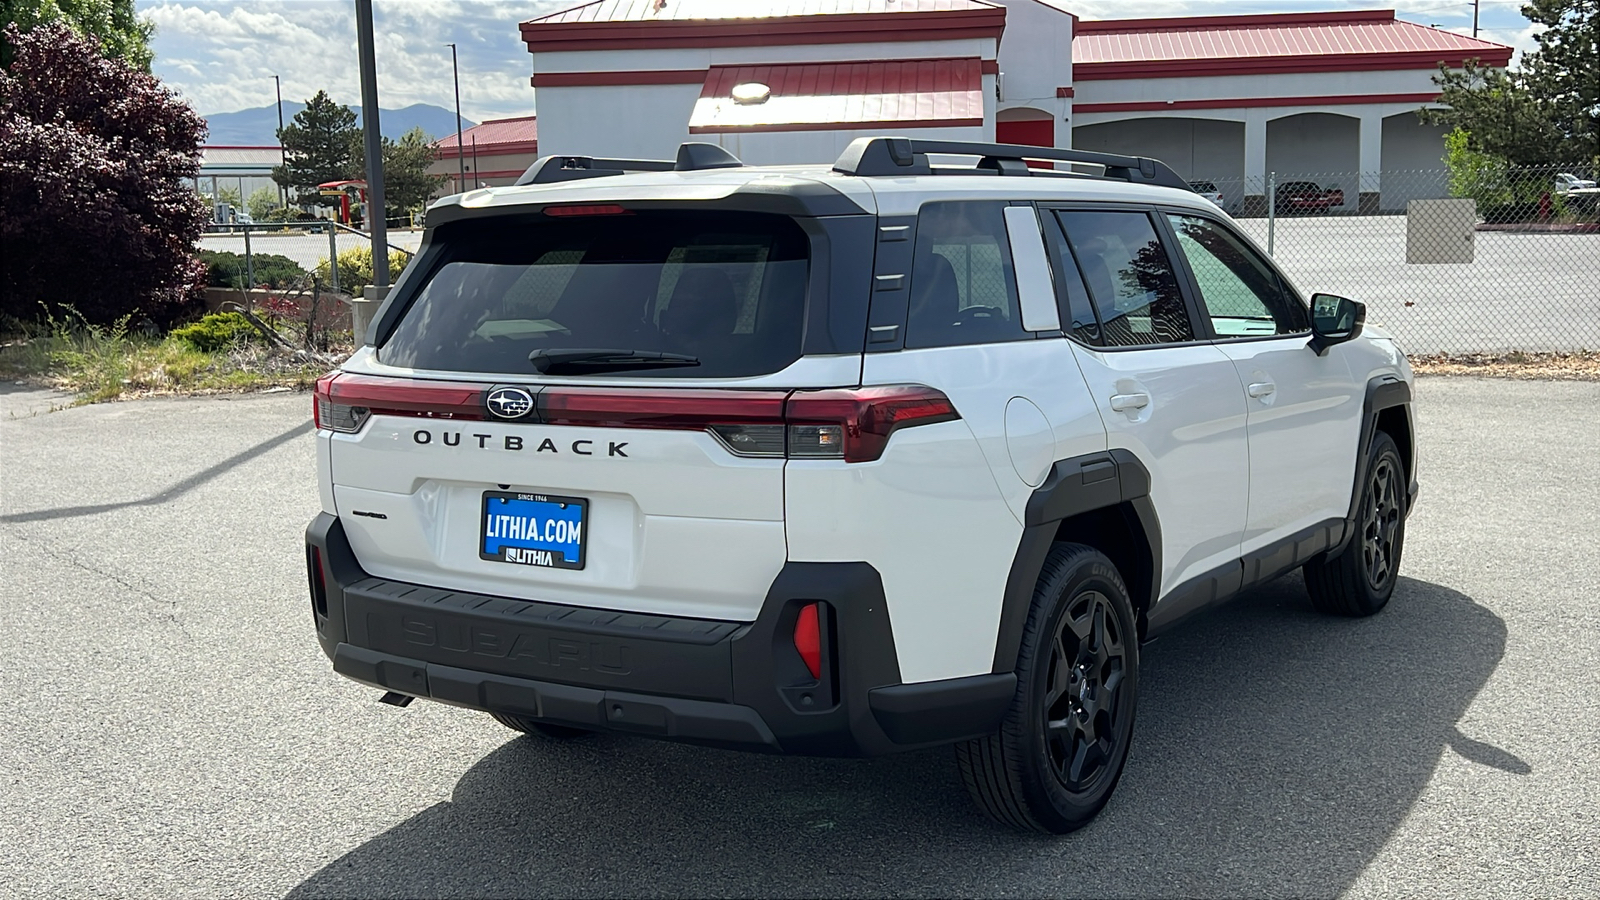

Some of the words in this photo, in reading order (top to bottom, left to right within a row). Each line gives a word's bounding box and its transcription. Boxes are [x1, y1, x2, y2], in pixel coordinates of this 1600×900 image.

[413, 430, 629, 457] OUTBACK
[486, 514, 582, 545] LITHIA.COM
[516, 548, 553, 566] LITHIA
[402, 615, 632, 675] SUBARU
